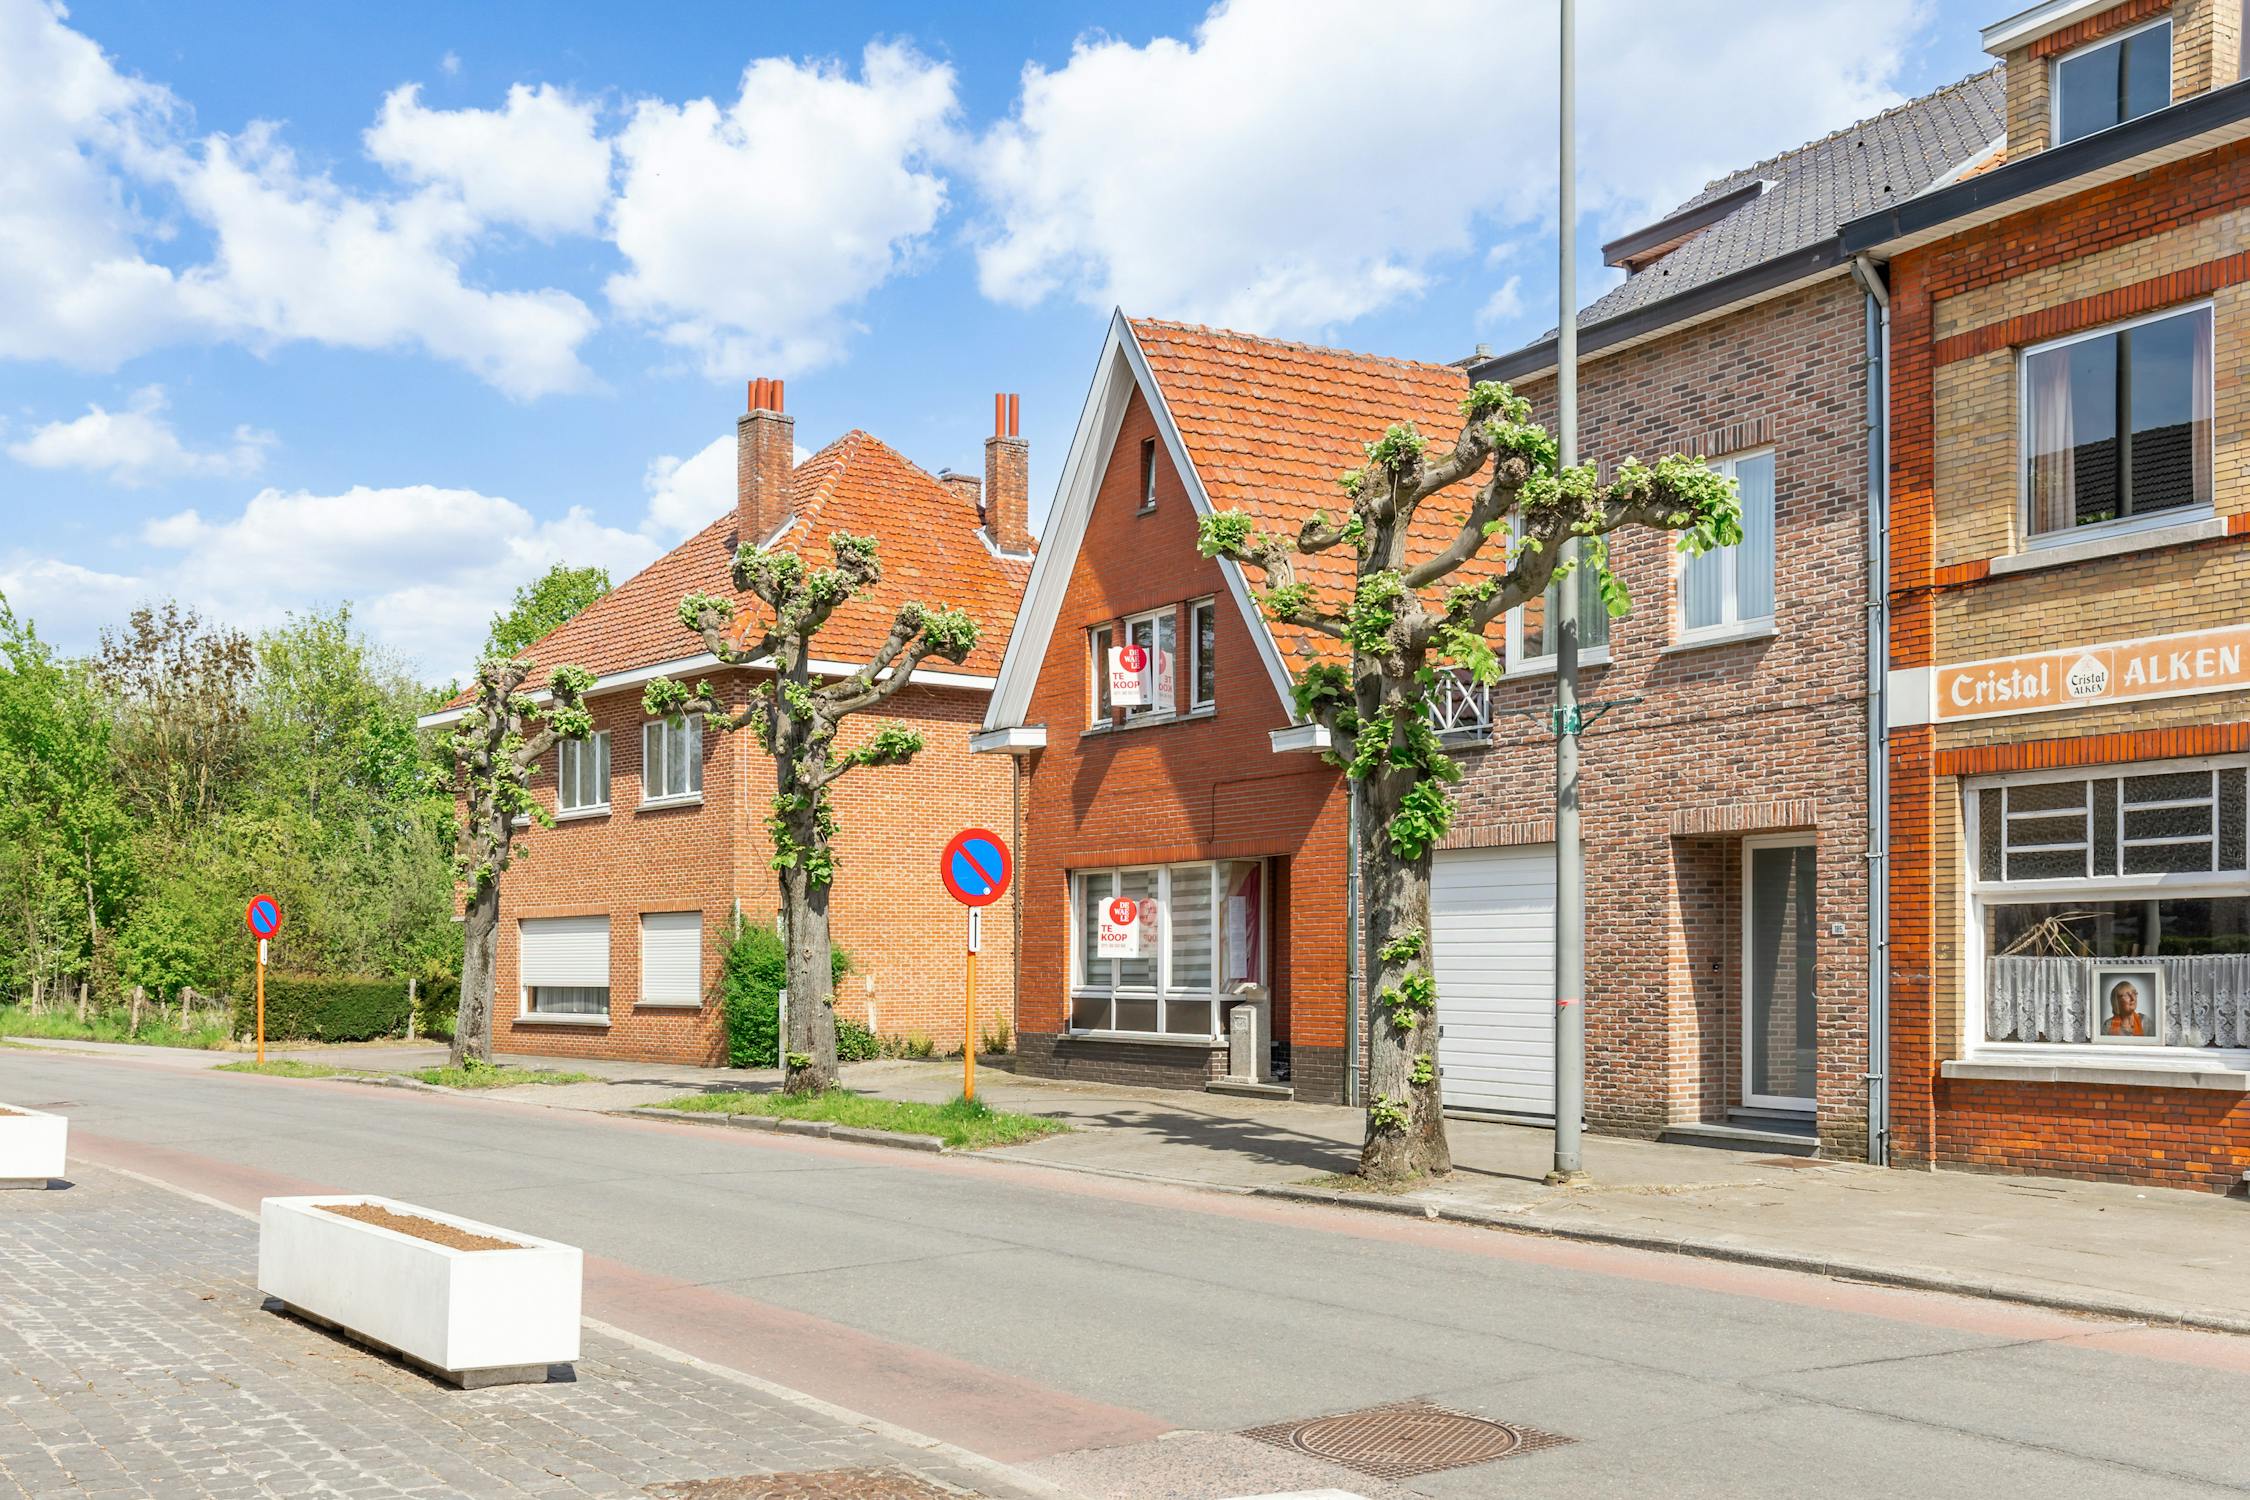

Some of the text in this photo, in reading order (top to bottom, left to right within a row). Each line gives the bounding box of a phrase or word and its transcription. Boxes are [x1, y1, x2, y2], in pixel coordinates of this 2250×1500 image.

[1112, 672, 1124, 680] TE
[1951, 644, 2241, 707] Cristal ALKEN
[2071, 672, 2104, 686] Cristal
[1113, 681, 1140, 689] KOOP
[2074, 684, 2102, 695] ALKEN
